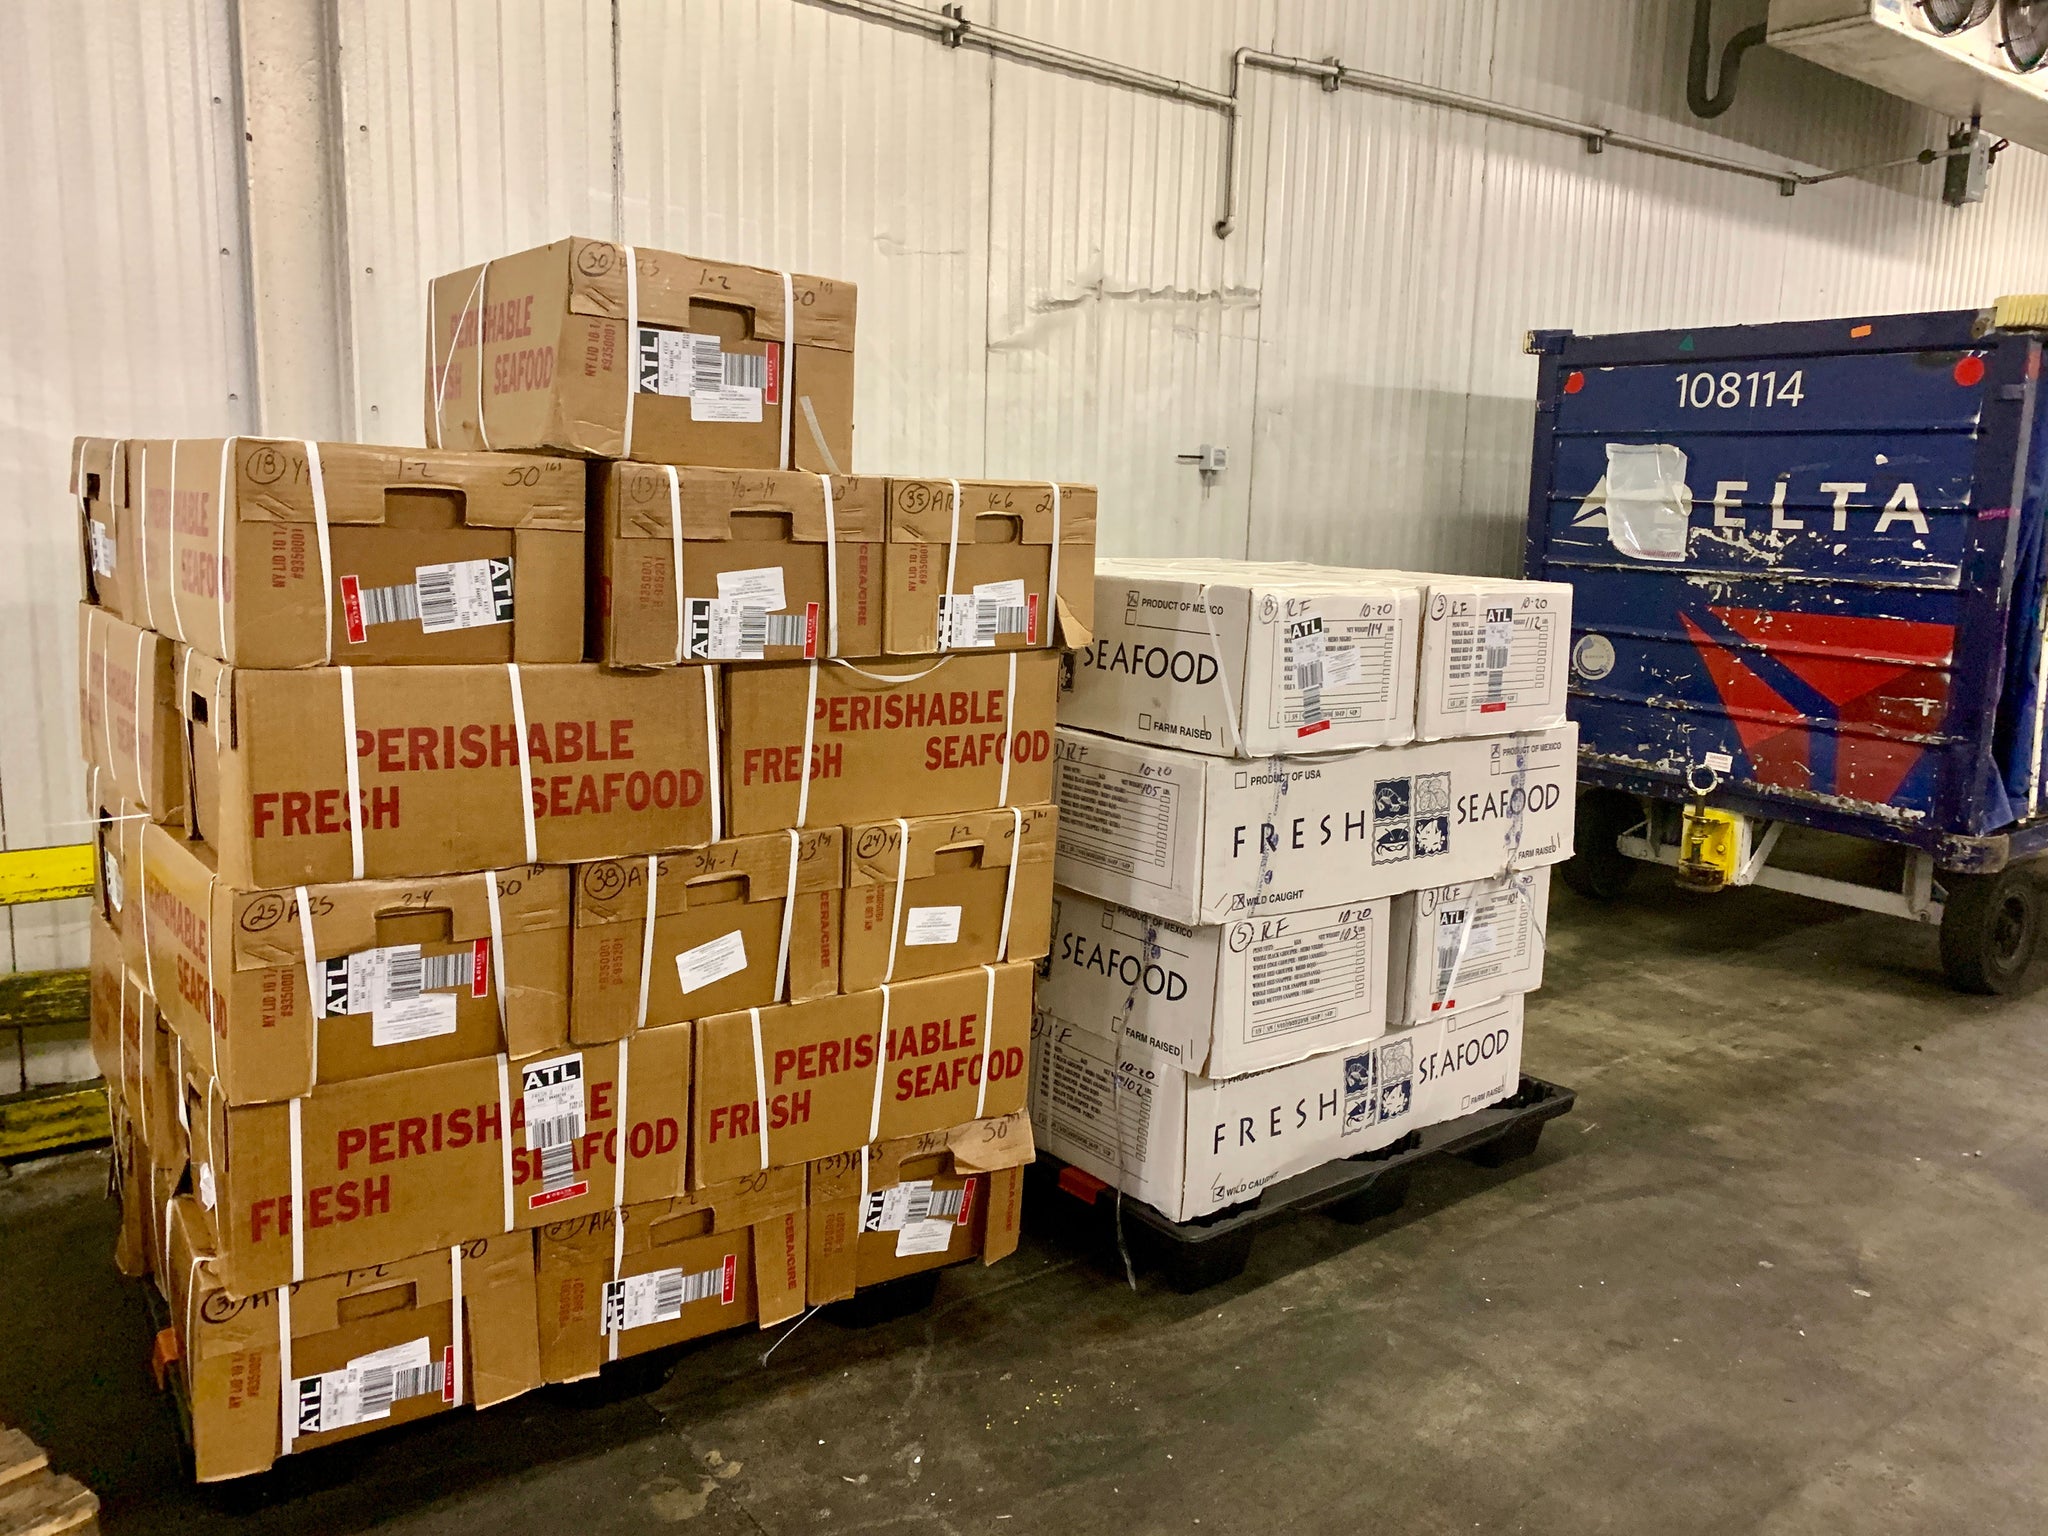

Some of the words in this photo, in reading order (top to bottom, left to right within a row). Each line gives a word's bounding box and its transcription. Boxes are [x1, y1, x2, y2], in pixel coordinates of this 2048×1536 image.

[584, 249, 610, 270] 30
[493, 345, 554, 395] SEAFOOD
[640, 337, 659, 393] ATL
[1675, 370, 1805, 409] 108114
[255, 453, 276, 478] 18
[501, 465, 543, 488] 50
[906, 491, 925, 507] 35
[272, 555, 286, 575] LID
[489, 558, 513, 618] ATL
[350, 598, 359, 625] DELTA
[1141, 598, 1179, 611] PRODUCT
[1179, 603, 1191, 612] OF
[1192, 604, 1224, 616] MEICO
[1359, 602, 1393, 618] 10-20
[1486, 608, 1512, 623] ATL
[692, 603, 709, 658] ATL
[1291, 620, 1321, 640] ATL
[1366, 622, 1383, 637] 114
[1083, 638, 1219, 685] SEAFOOD
[813, 690, 1004, 732] PERISHABLE
[1153, 721, 1178, 735] FARM
[1179, 724, 1213, 741] RAISED
[925, 729, 1050, 771] SEAFOOD
[1530, 744, 1540, 753] OF
[1540, 741, 1562, 752] MEXICO
[743, 743, 842, 786] FRESH
[1141, 782, 1162, 797] 105
[1250, 772, 1290, 786] PRODUCT
[1291, 771, 1302, 781] OF
[1304, 769, 1322, 780] USA
[529, 768, 705, 820] SEAFOOD
[1233, 810, 1366, 858] FRESH
[1456, 782, 1560, 825] SEAFOOD
[863, 832, 881, 851] 24
[1518, 848, 1535, 860] FARM
[593, 867, 619, 892] 38
[1268, 889, 1304, 904] CAUGHT
[250, 904, 277, 923] 25
[1338, 907, 1373, 924] 10-20
[1440, 909, 1464, 925] ATL
[1152, 917, 1163, 928] OF
[1164, 919, 1193, 939] MEXICO
[1261, 917, 1290, 942] RF
[1061, 932, 1188, 1001] SEAFOOD
[328, 958, 348, 1015] ATL
[262, 992, 276, 1011] LID
[773, 1014, 977, 1085] PERISHABLE
[1125, 1026, 1148, 1043] FARM
[1149, 1036, 1181, 1057] RAISED
[524, 1065, 577, 1090] ATL
[895, 1046, 1024, 1102] SEAFOOD
[1120, 1060, 1156, 1080] 10-20
[1124, 1077, 1144, 1097] 102
[1213, 1088, 1338, 1155] FRESH
[1418, 1028, 1509, 1085] SEAFOOD
[1226, 1184, 1247, 1197] WILD
[866, 1190, 885, 1231] ATL
[300, 1381, 321, 1432] ATL
